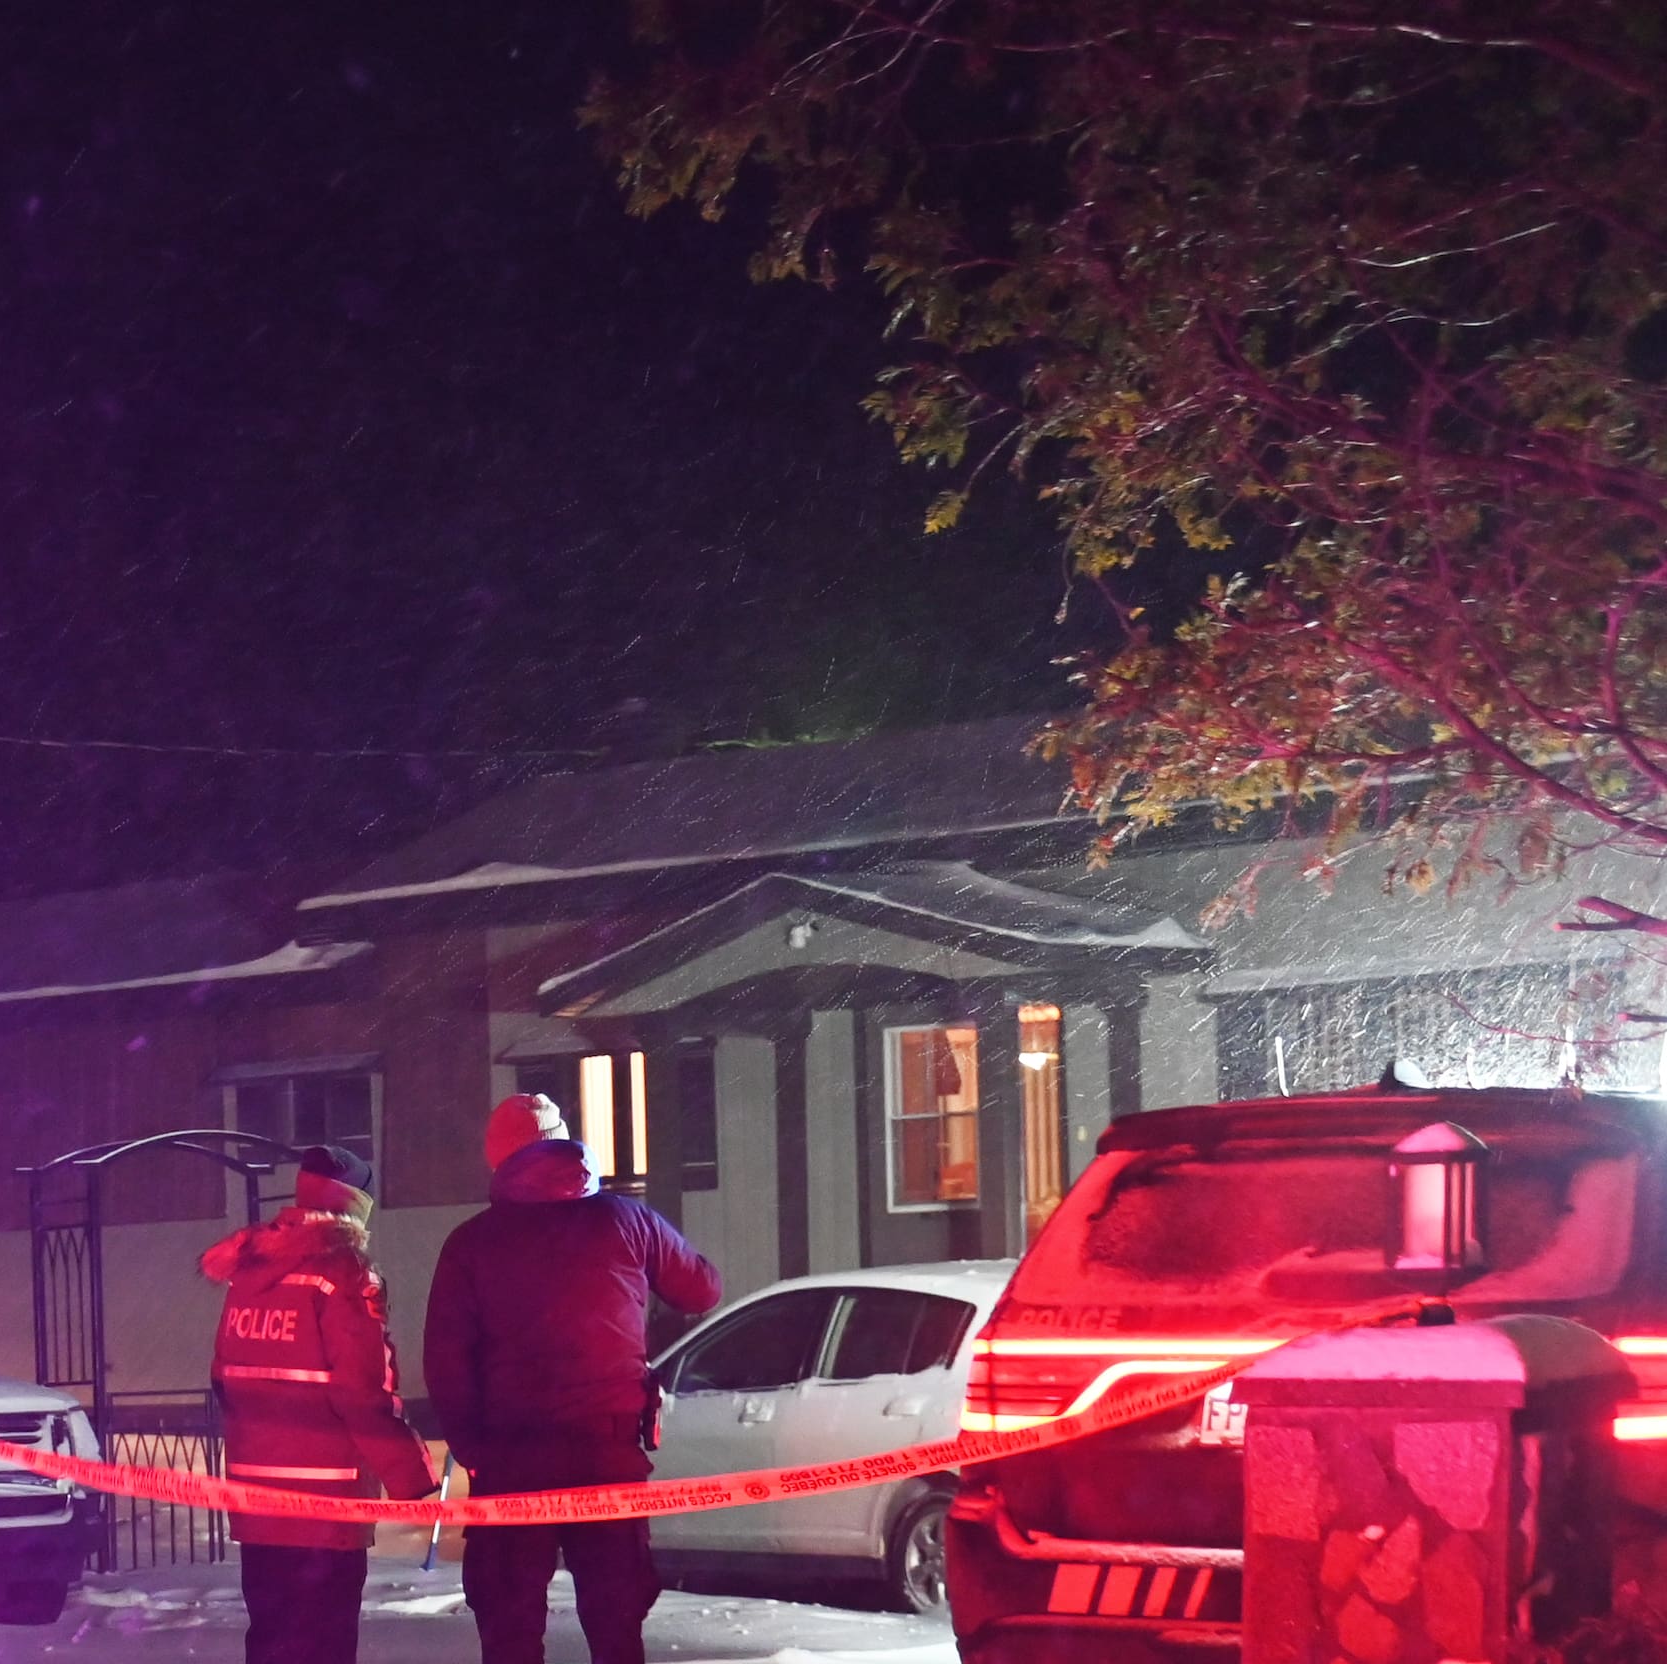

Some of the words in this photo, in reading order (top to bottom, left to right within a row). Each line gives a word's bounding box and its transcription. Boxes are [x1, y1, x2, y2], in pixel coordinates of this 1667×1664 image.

[226, 1307, 299, 1341] POLICE
[1020, 1307, 1120, 1331] POLICE
[861, 1461, 917, 1481] SÛRETÉ
[862, 1455, 895, 1470] 800
[779, 1463, 859, 1482] 711-1800
[839, 1471, 860, 1484] DU
[780, 1476, 837, 1494] QUÉBEC
[630, 1497, 686, 1513] INTERDIT
